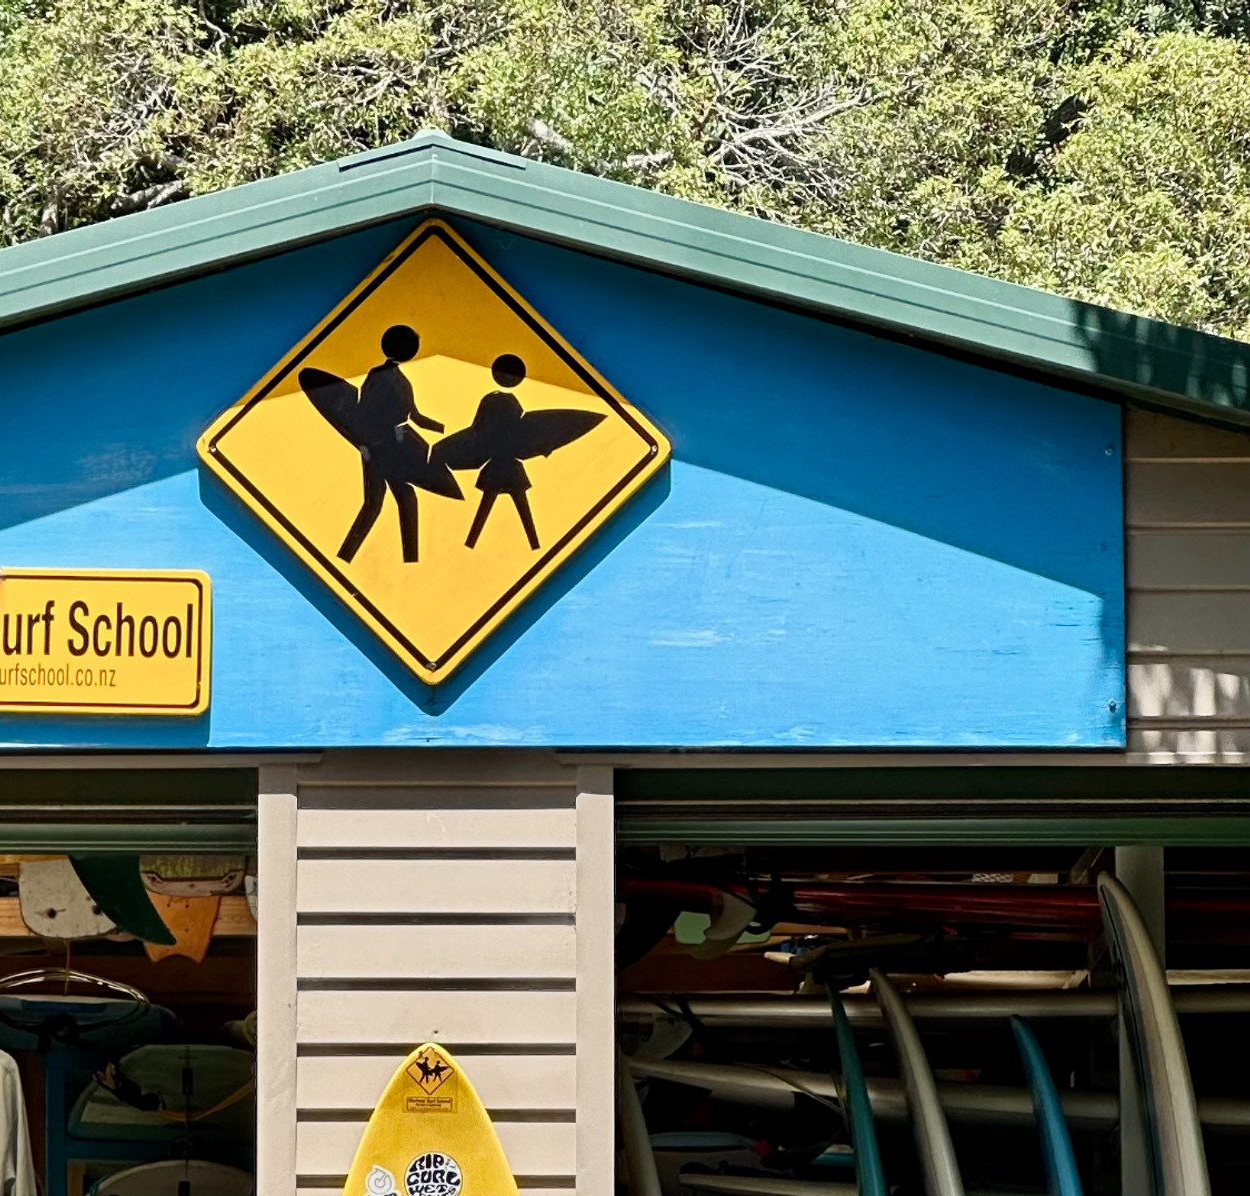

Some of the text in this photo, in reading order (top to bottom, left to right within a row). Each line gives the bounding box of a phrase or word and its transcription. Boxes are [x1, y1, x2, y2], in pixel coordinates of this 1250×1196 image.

[67, 600, 194, 659] School
[409, 1153, 445, 1172] RIP
[406, 1169, 461, 1187] CURL
